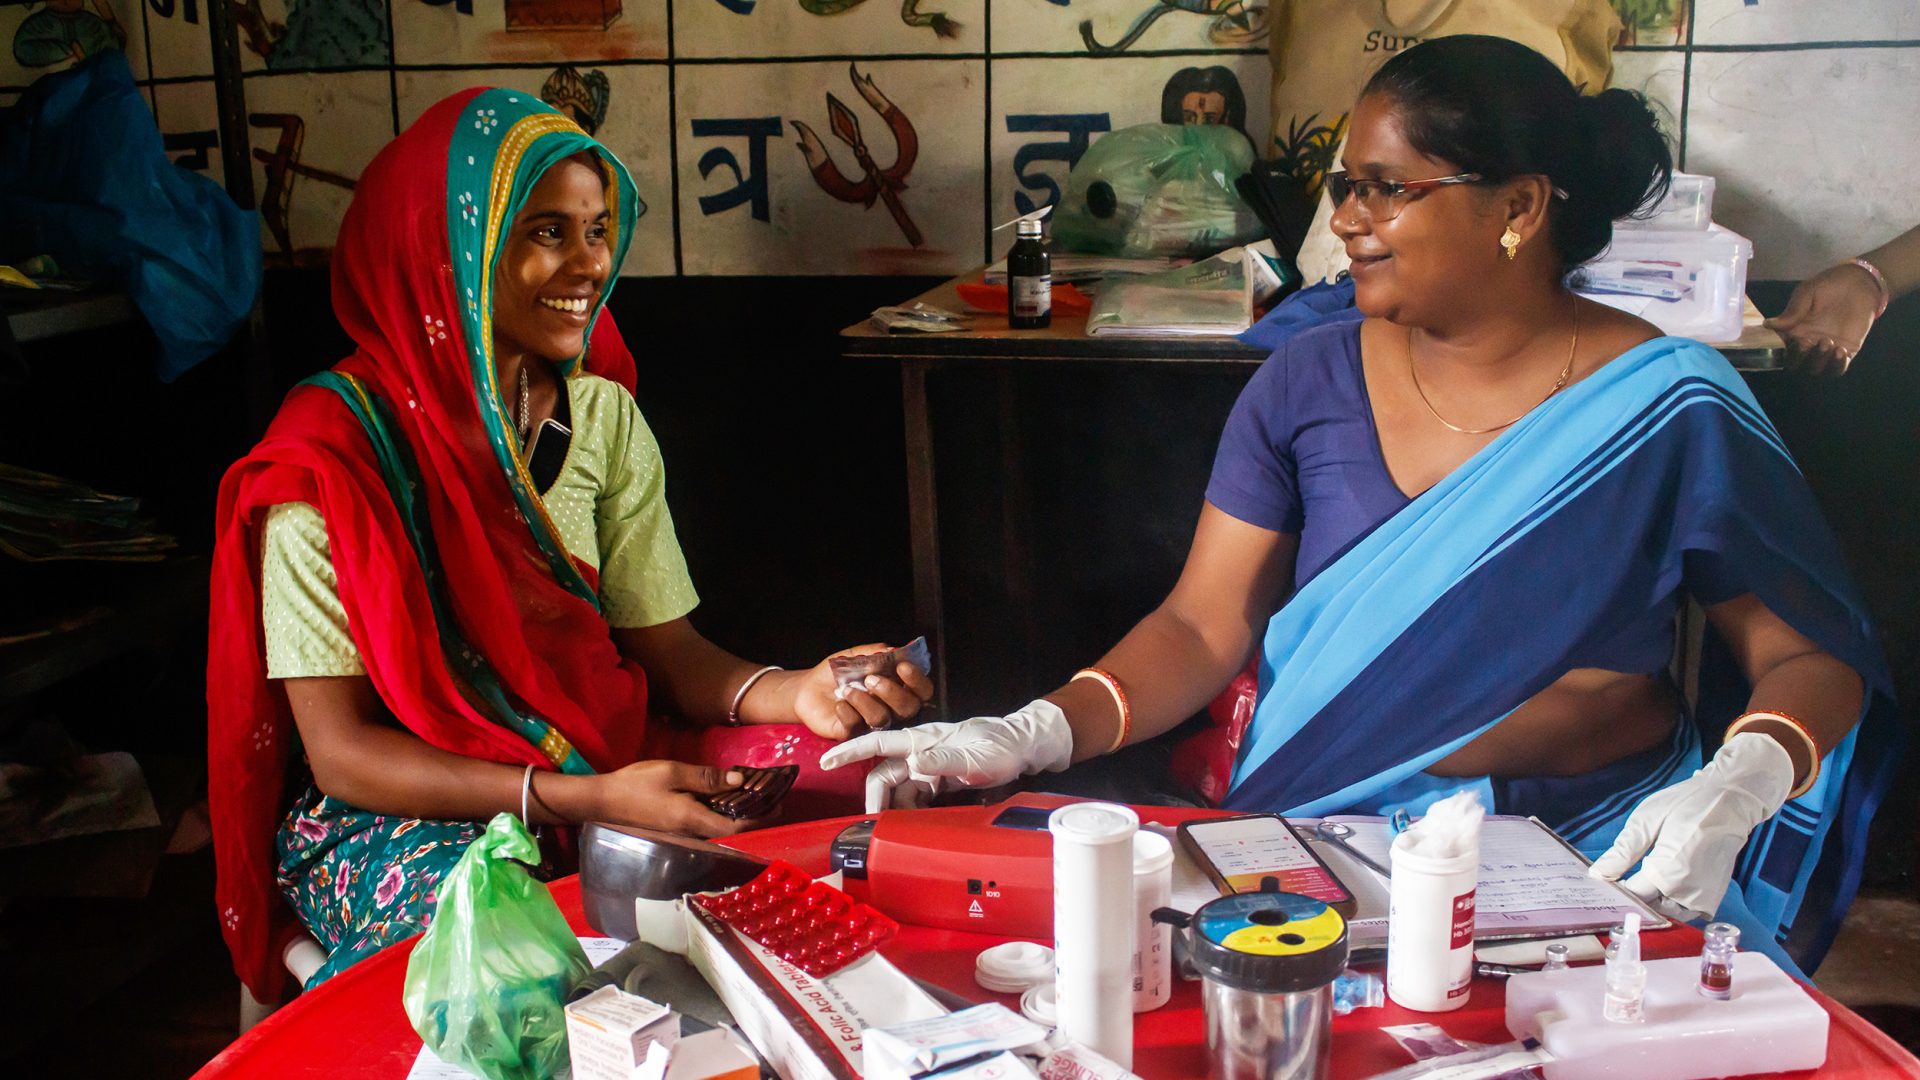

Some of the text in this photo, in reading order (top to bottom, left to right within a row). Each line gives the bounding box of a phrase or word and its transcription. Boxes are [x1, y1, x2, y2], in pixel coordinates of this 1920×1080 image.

[691, 115, 783, 222] त्र
[804, 987, 836, 1014] Acid
[829, 1013, 860, 1042] Folic
[850, 1043, 863, 1053] &
